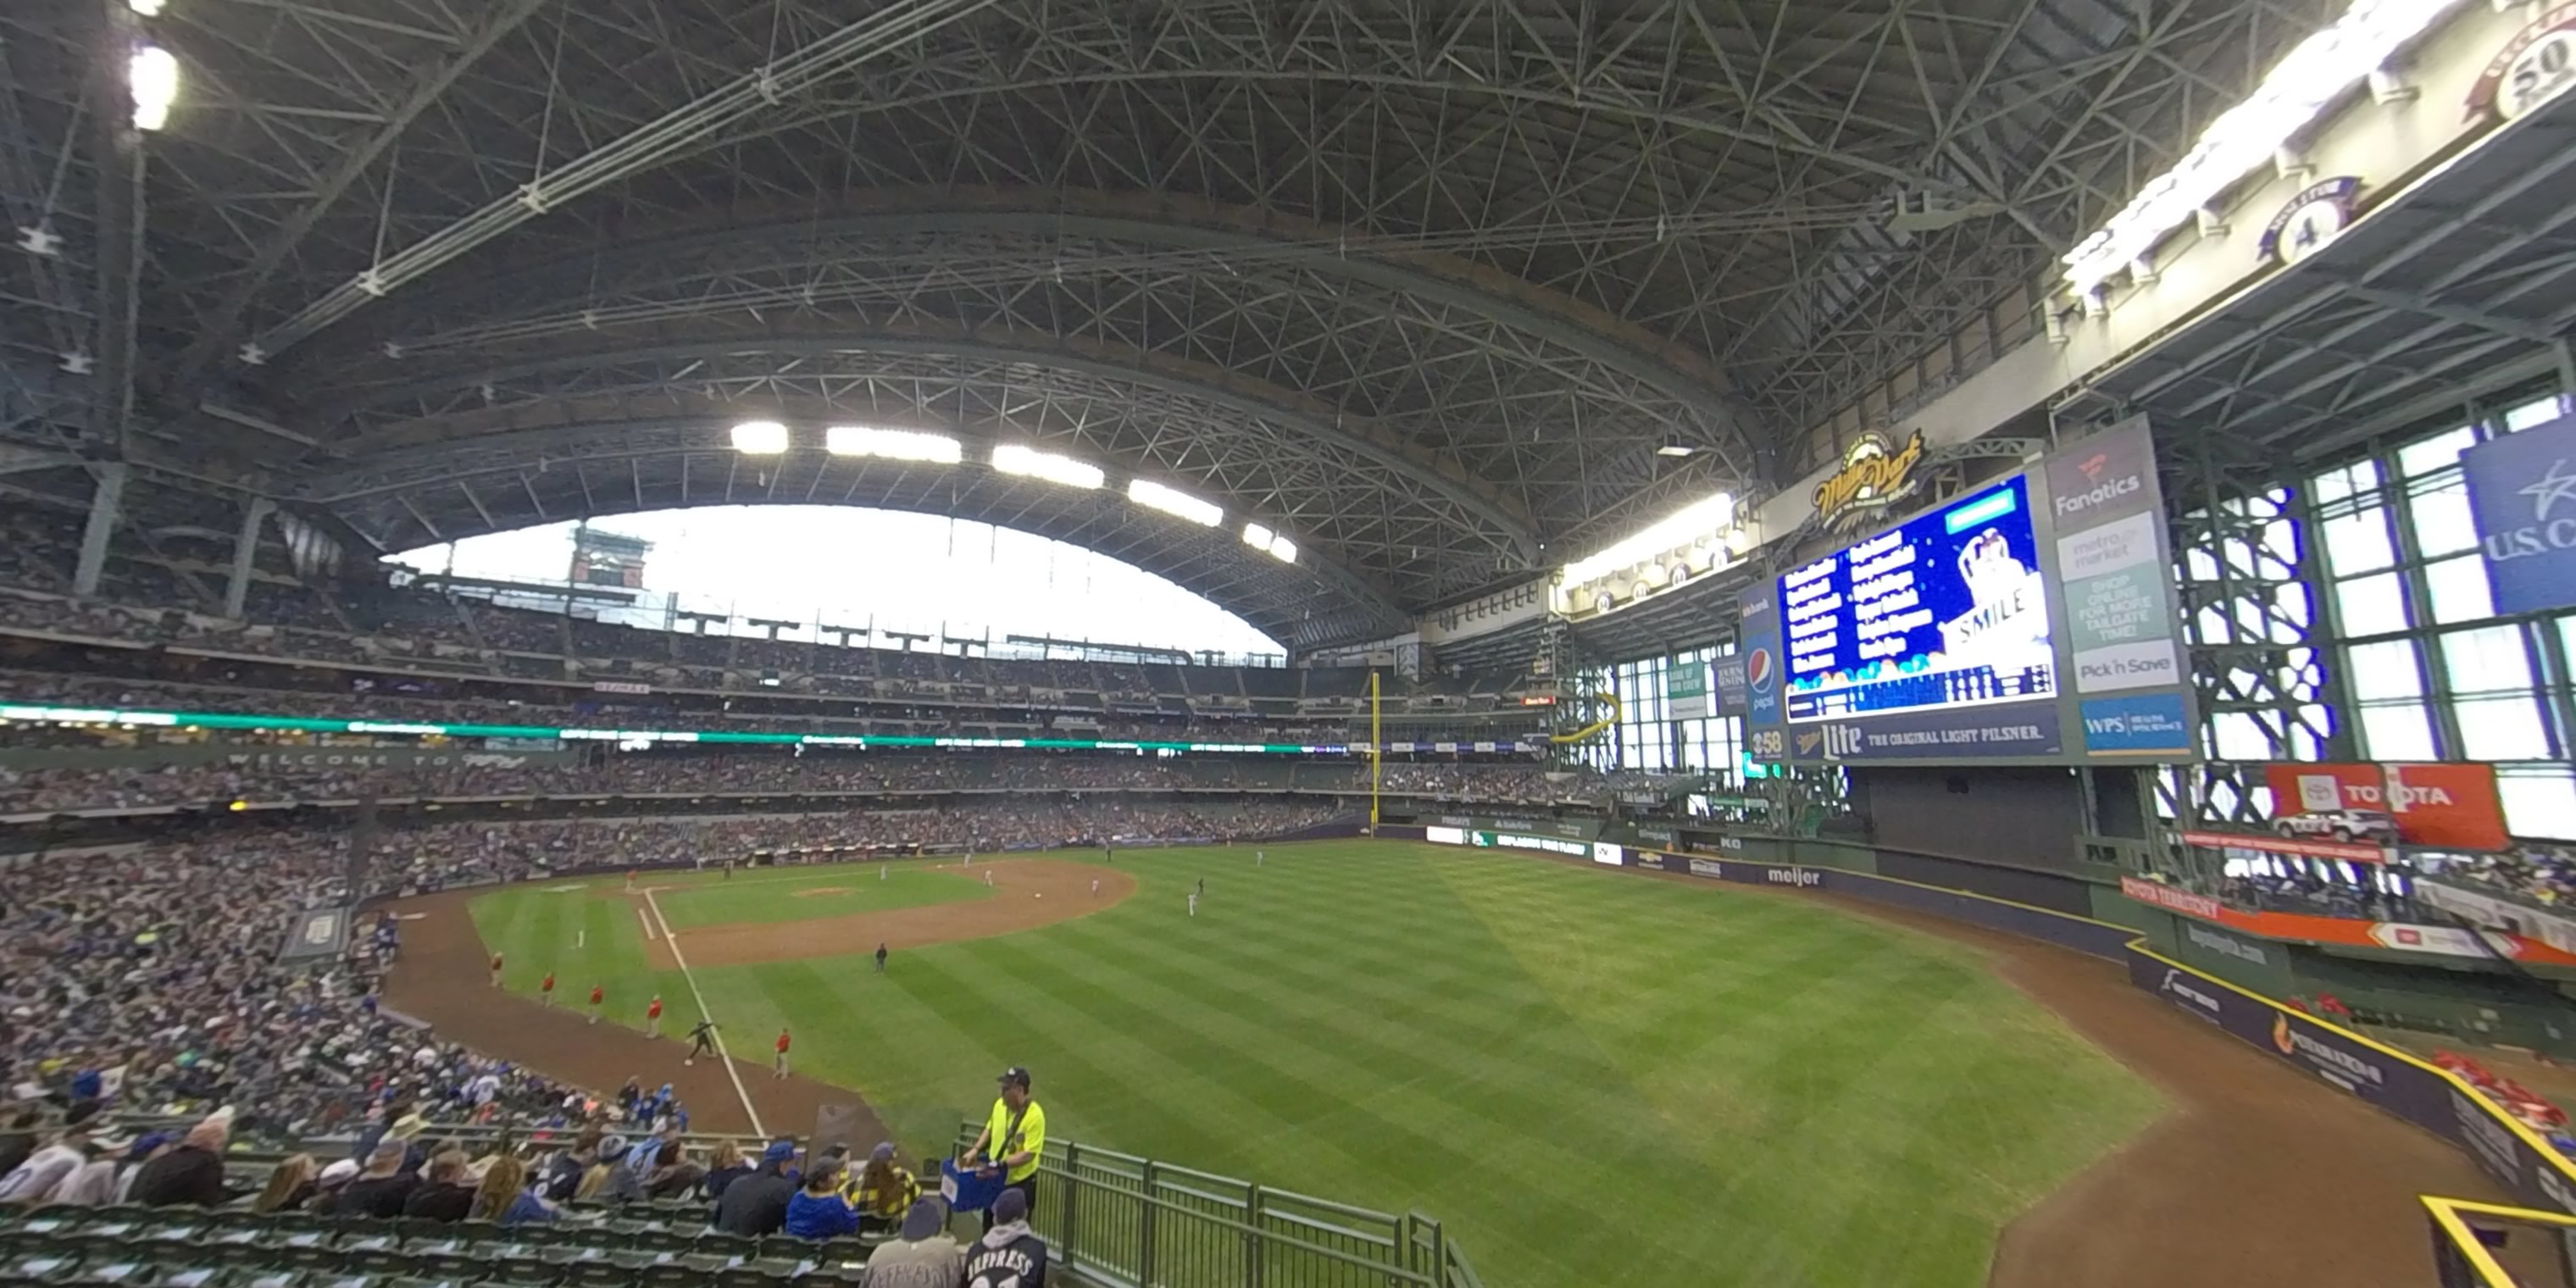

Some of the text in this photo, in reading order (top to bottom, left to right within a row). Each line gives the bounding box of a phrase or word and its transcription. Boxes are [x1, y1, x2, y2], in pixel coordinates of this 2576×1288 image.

[2513, 37, 2570, 97] 50
[2296, 216, 2318, 247] 4
[2055, 475, 2140, 516] Fanatics
[2074, 533, 2119, 554] metro
[2075, 544, 2129, 569] market
[1959, 587, 2025, 644] SMILE
[2079, 596, 2152, 620] FOR MORE
[2085, 609, 2150, 631] TAILGATE
[2080, 663, 2113, 679] Pick
[2128, 658, 2171, 674] Save
[1753, 695, 1775, 712] pepsi
[2086, 717, 2126, 734] WPS
[1763, 731, 1783, 753] 58
[1868, 734, 1888, 747] THE
[1890, 731, 1940, 746] ORIGINAL
[1940, 729, 1979, 743] LIGHT
[228, 753, 386, 765] WELCOME
[413, 756, 449, 766] TO
[2344, 786, 2454, 805] TOOTA
[1768, 867, 1820, 887] meijer
[2158, 887, 2218, 919] TERRITORY
